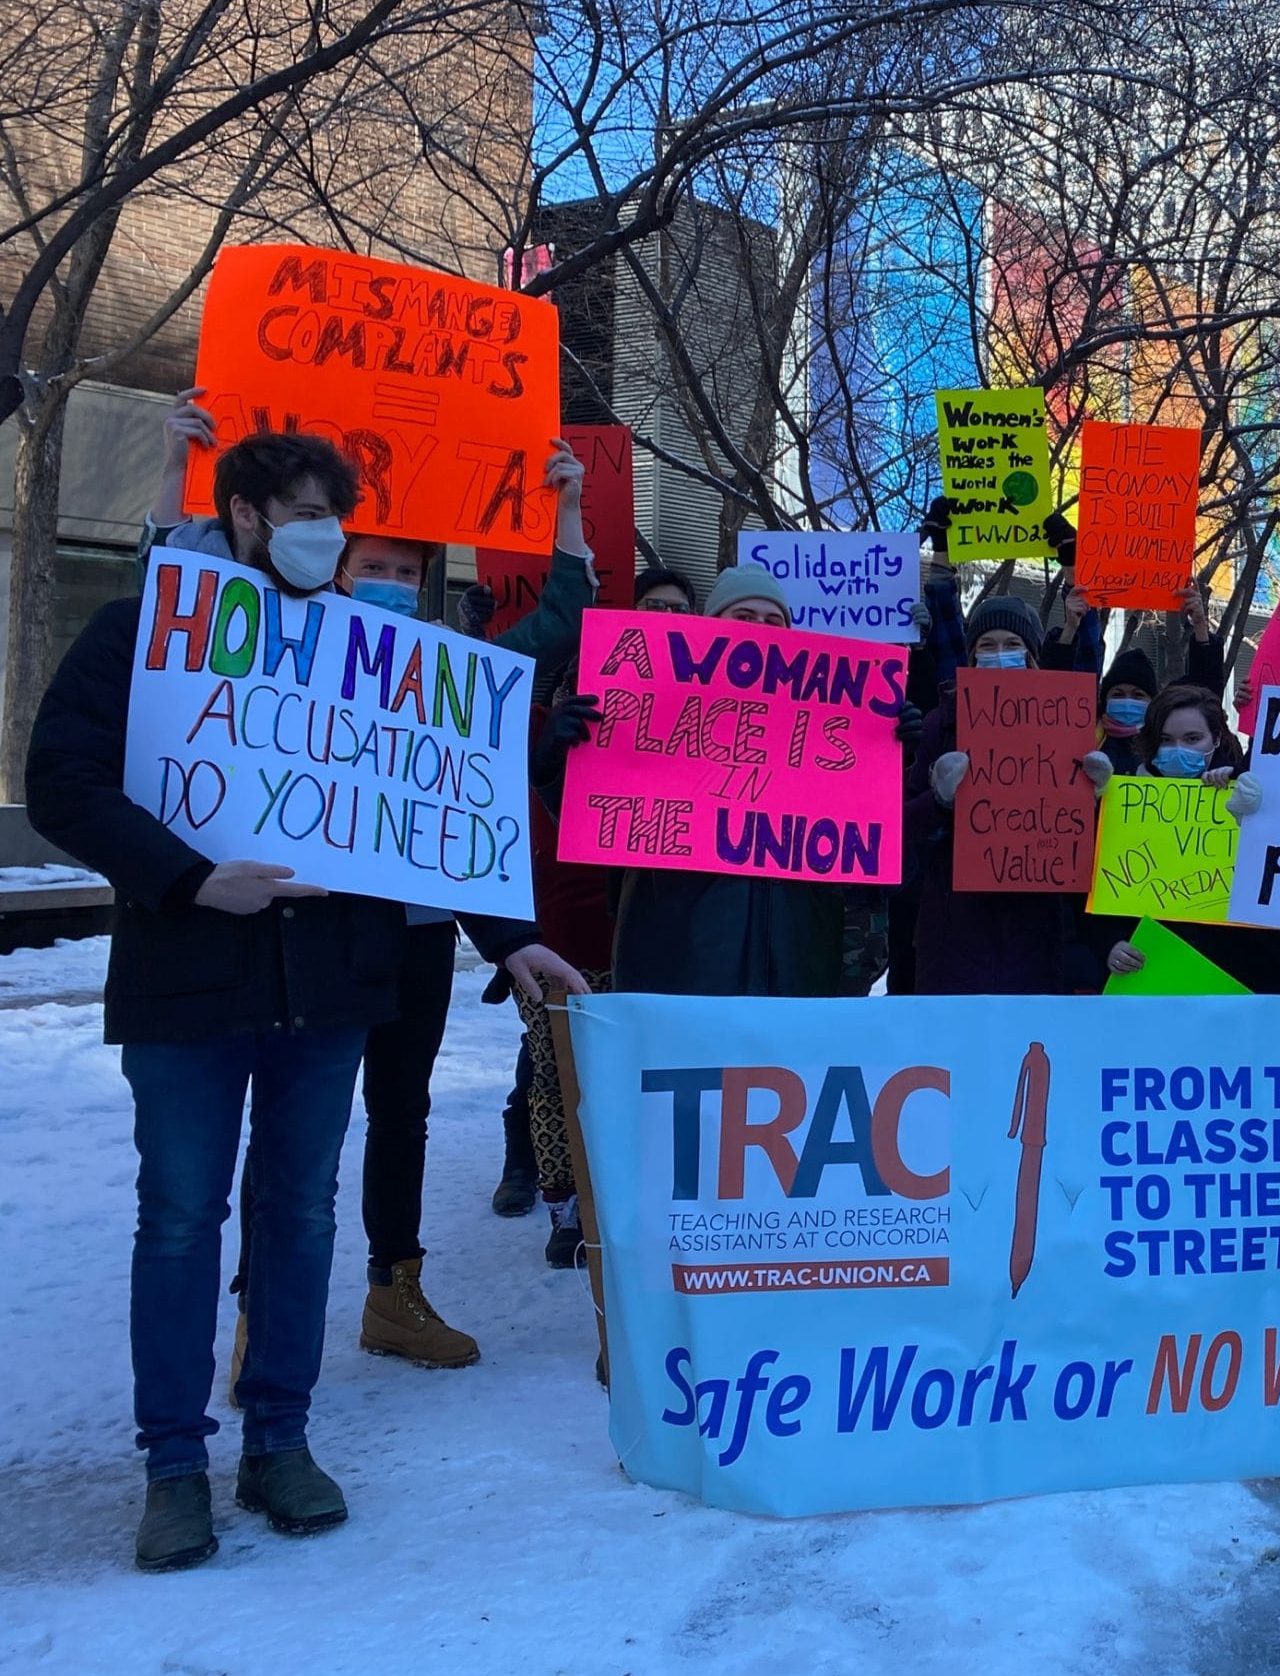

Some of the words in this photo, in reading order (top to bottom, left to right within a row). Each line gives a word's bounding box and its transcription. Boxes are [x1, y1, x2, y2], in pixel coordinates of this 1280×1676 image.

[943, 401, 1045, 428] Women's
[946, 454, 995, 469] makes
[1008, 452, 1033, 468] the
[1111, 425, 1168, 466] THE
[952, 476, 997, 490] world
[1082, 466, 1197, 503] ECONOMY
[1090, 497, 1118, 526] IS
[1124, 501, 1182, 531] BUILT
[751, 544, 903, 579] Solidarity
[1081, 531, 1119, 558] ON
[1125, 533, 1195, 564] WOMENS
[817, 575, 880, 596] with
[145, 564, 326, 688] HOW
[341, 615, 525, 750] MANY
[599, 628, 654, 679] A
[667, 631, 905, 718] WOMAN'S
[186, 679, 495, 808] ACCUSATIONS
[597, 688, 769, 764] PLACE
[788, 709, 857, 771] IS
[708, 763, 773, 802] IN
[966, 744, 1058, 788] Work
[158, 756, 226, 830] DO
[253, 768, 359, 854] YOU
[373, 791, 520, 882] NEED?
[588, 795, 693, 856] THE
[716, 807, 882, 877] UNION
[969, 798, 1086, 836] Creates
[984, 840, 1079, 886] Value!
[1101, 839, 1158, 899] NOT
[1101, 1066, 1252, 1111] FROM
[641, 1066, 950, 1200] TRAC
[1100, 1173, 1171, 1221] TO
[669, 1210, 781, 1232] TEACHING
[787, 1208, 836, 1229] AND
[844, 1206, 950, 1227] RESEARCH
[668, 1231, 787, 1252] ASSISTANTS
[793, 1231, 817, 1249] AT
[824, 1228, 950, 1247] CONCORDIA
[683, 1264, 931, 1290] WWW.TRAC-UNION.CA
[661, 1346, 812, 1467] Safe
[836, 1339, 1037, 1433] Work
[1053, 1358, 1134, 1421] or
[1145, 1330, 1243, 1416] NO
